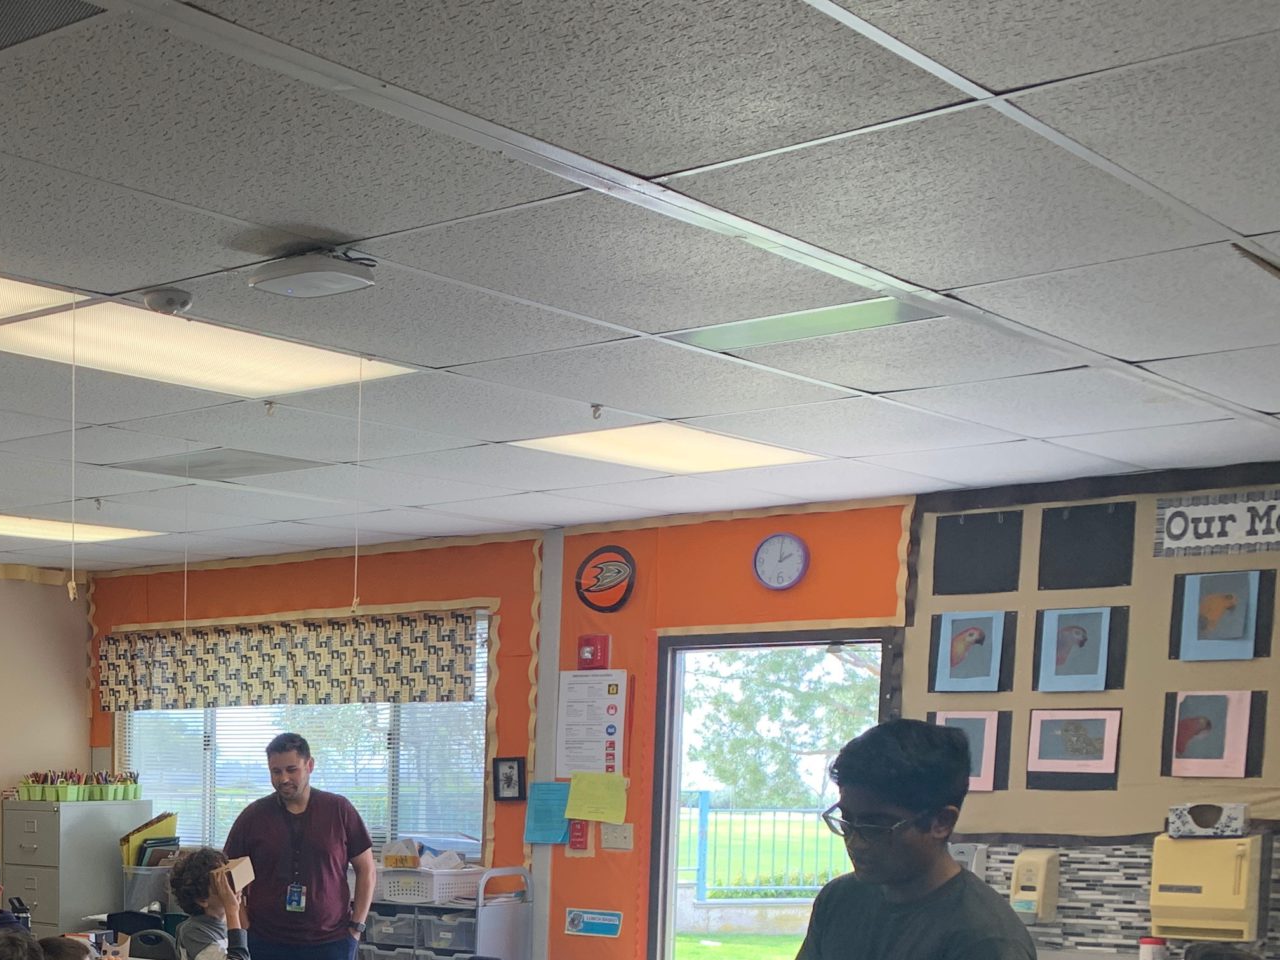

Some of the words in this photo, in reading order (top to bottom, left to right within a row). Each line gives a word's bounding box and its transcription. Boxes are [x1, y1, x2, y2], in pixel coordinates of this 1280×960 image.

[1166, 511, 1237, 540] Our
[1246, 505, 1280, 536] M
[777, 571, 784, 584] 6
